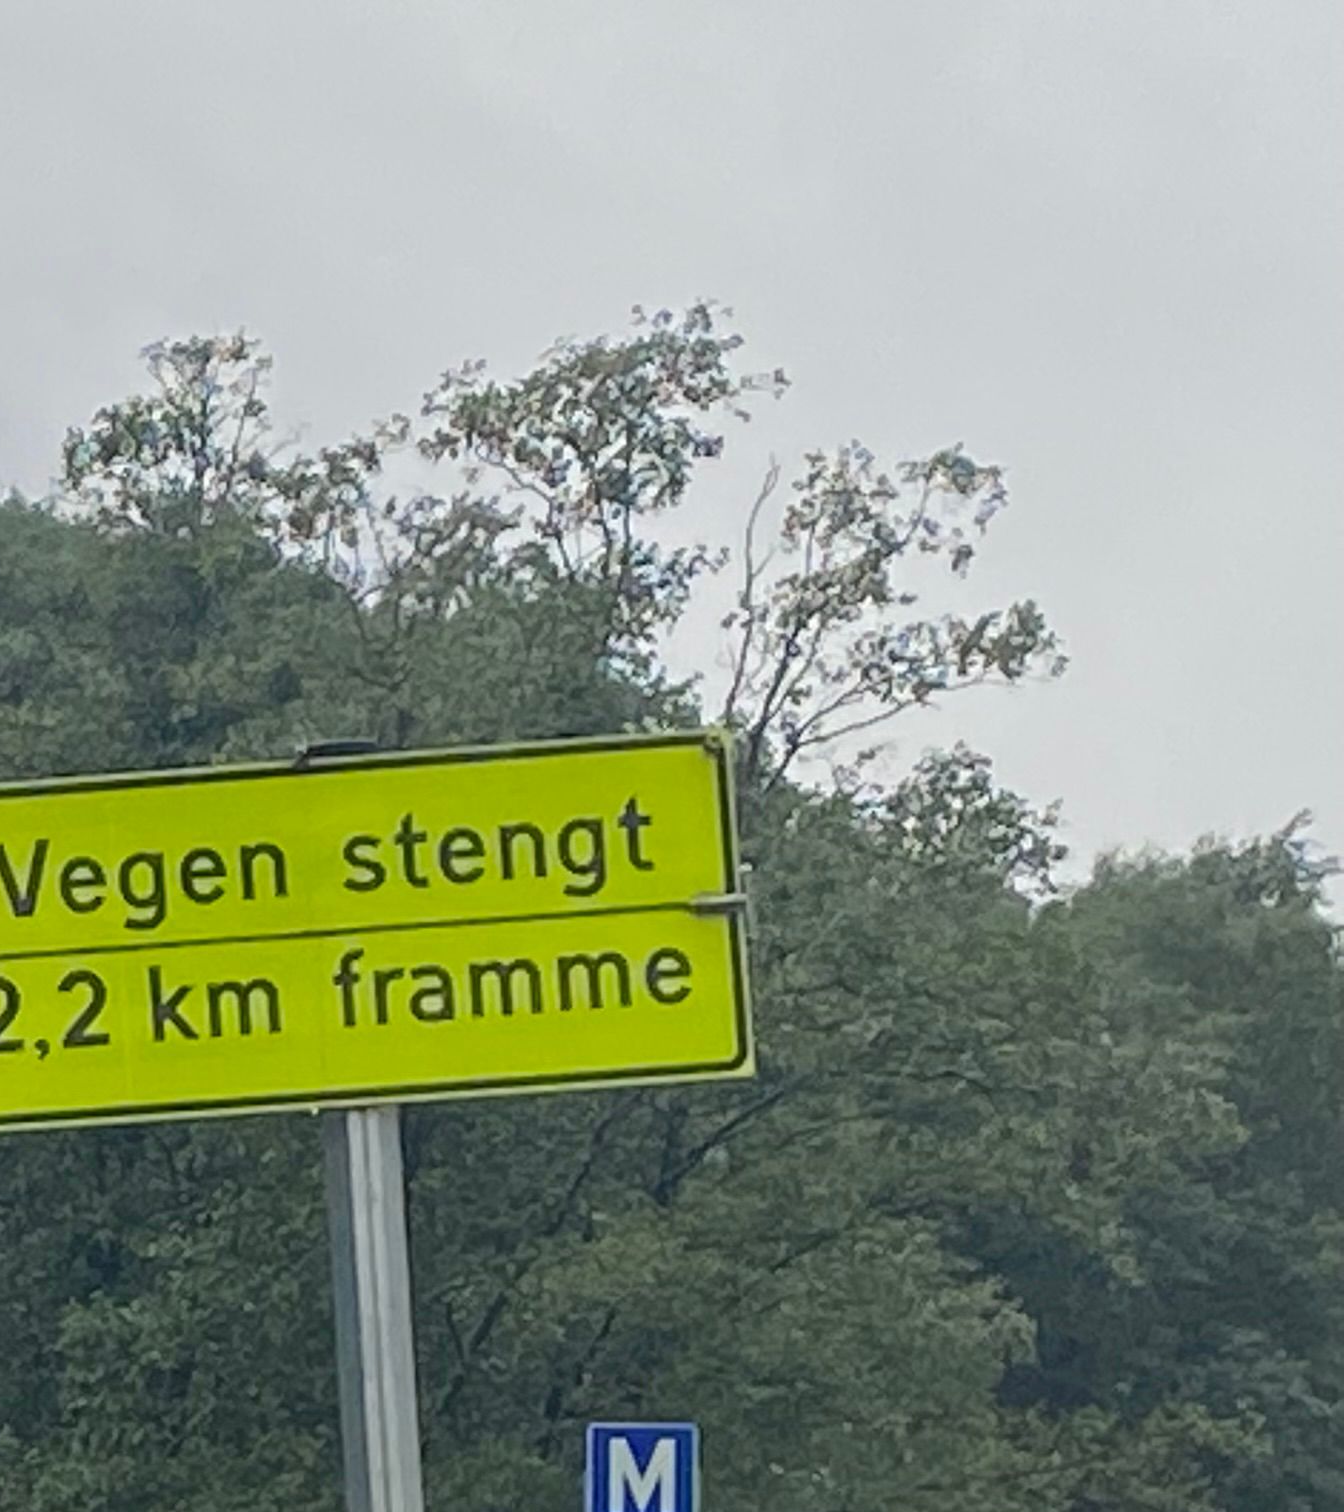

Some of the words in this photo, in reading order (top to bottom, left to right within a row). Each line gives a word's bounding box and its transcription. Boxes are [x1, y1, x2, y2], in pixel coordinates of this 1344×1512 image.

[342, 796, 654, 897] stengt
[148, 965, 282, 1041] km
[333, 948, 692, 1028] framme
